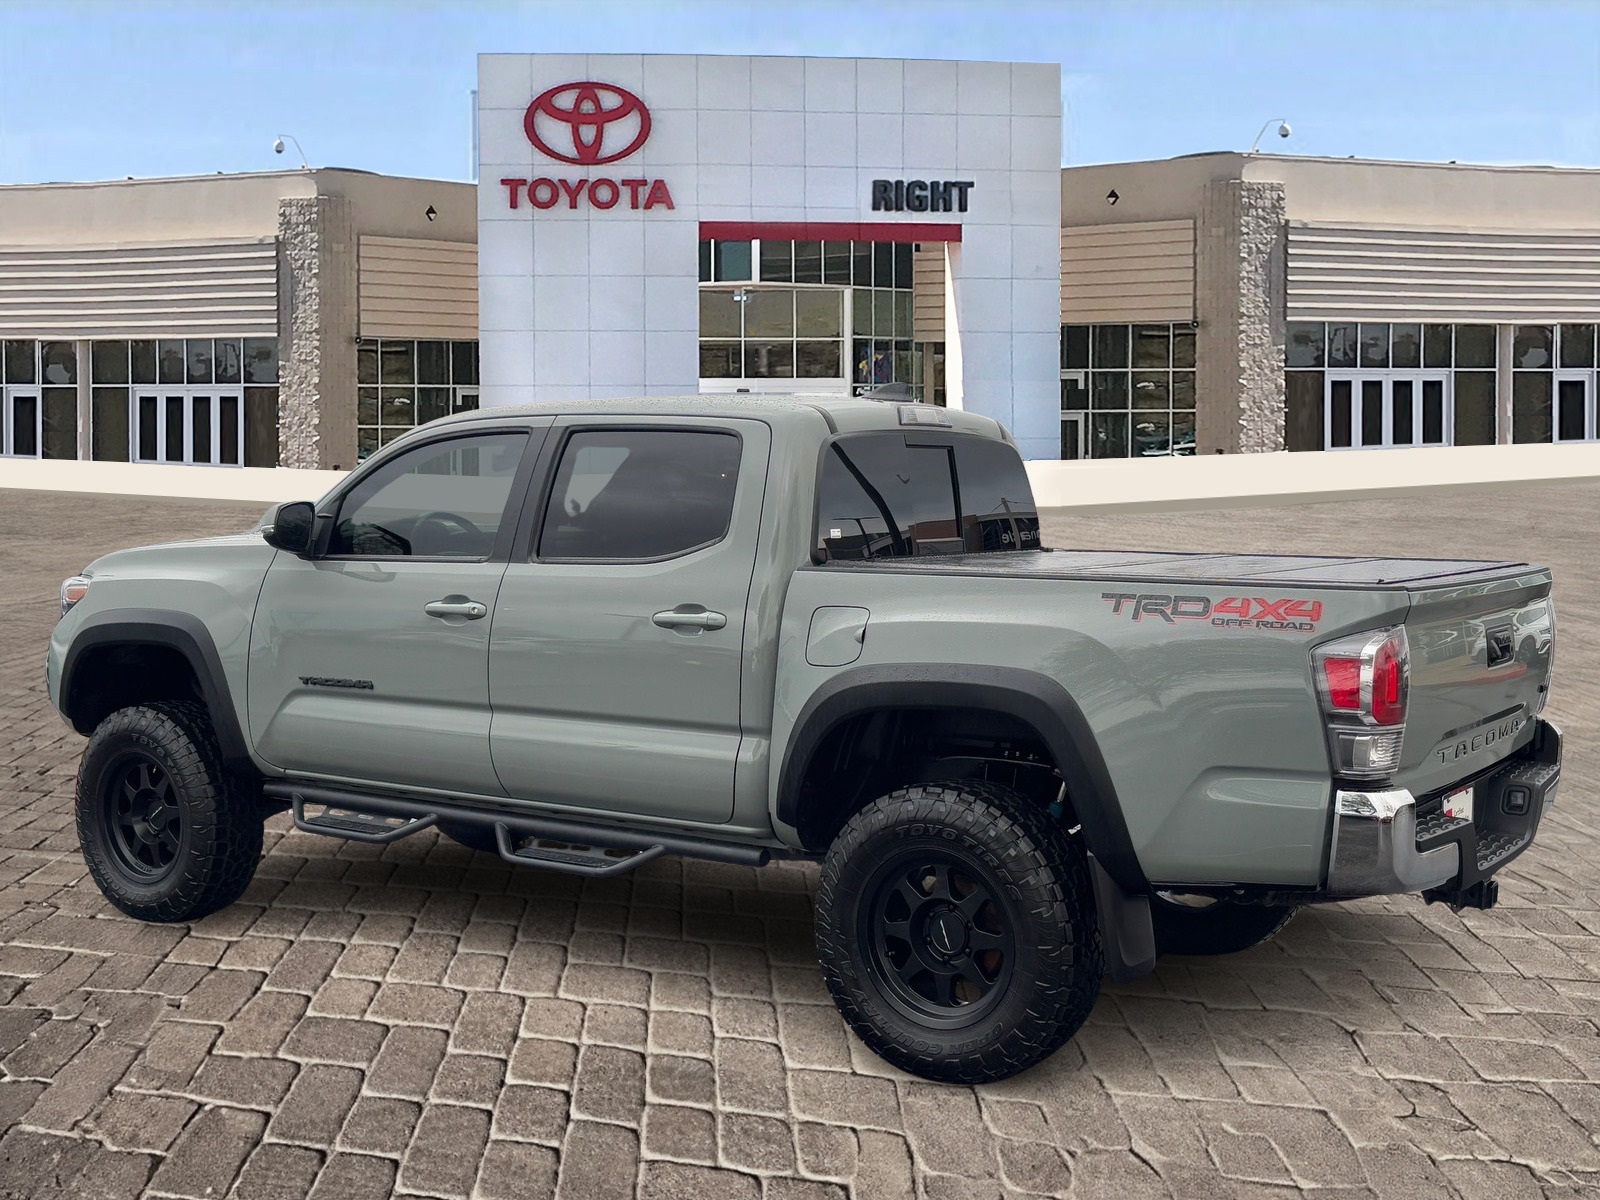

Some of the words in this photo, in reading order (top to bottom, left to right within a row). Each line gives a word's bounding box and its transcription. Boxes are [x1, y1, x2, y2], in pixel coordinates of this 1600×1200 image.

[500, 177, 675, 210] TOYOTA
[872, 179, 975, 212] RIGHT
[1101, 592, 1213, 626] TRD
[1213, 597, 1323, 622] 4X4
[1211, 617, 1252, 630] OFF
[1255, 621, 1317, 633] ROAD
[298, 676, 374, 690] TACOMA
[1437, 717, 1520, 765] TACOMA
[895, 823, 958, 841] TOYO
[961, 836, 1023, 902] TIRES
[850, 988, 943, 1055] COUNTRY
[947, 1022, 1003, 1055] OPEN
